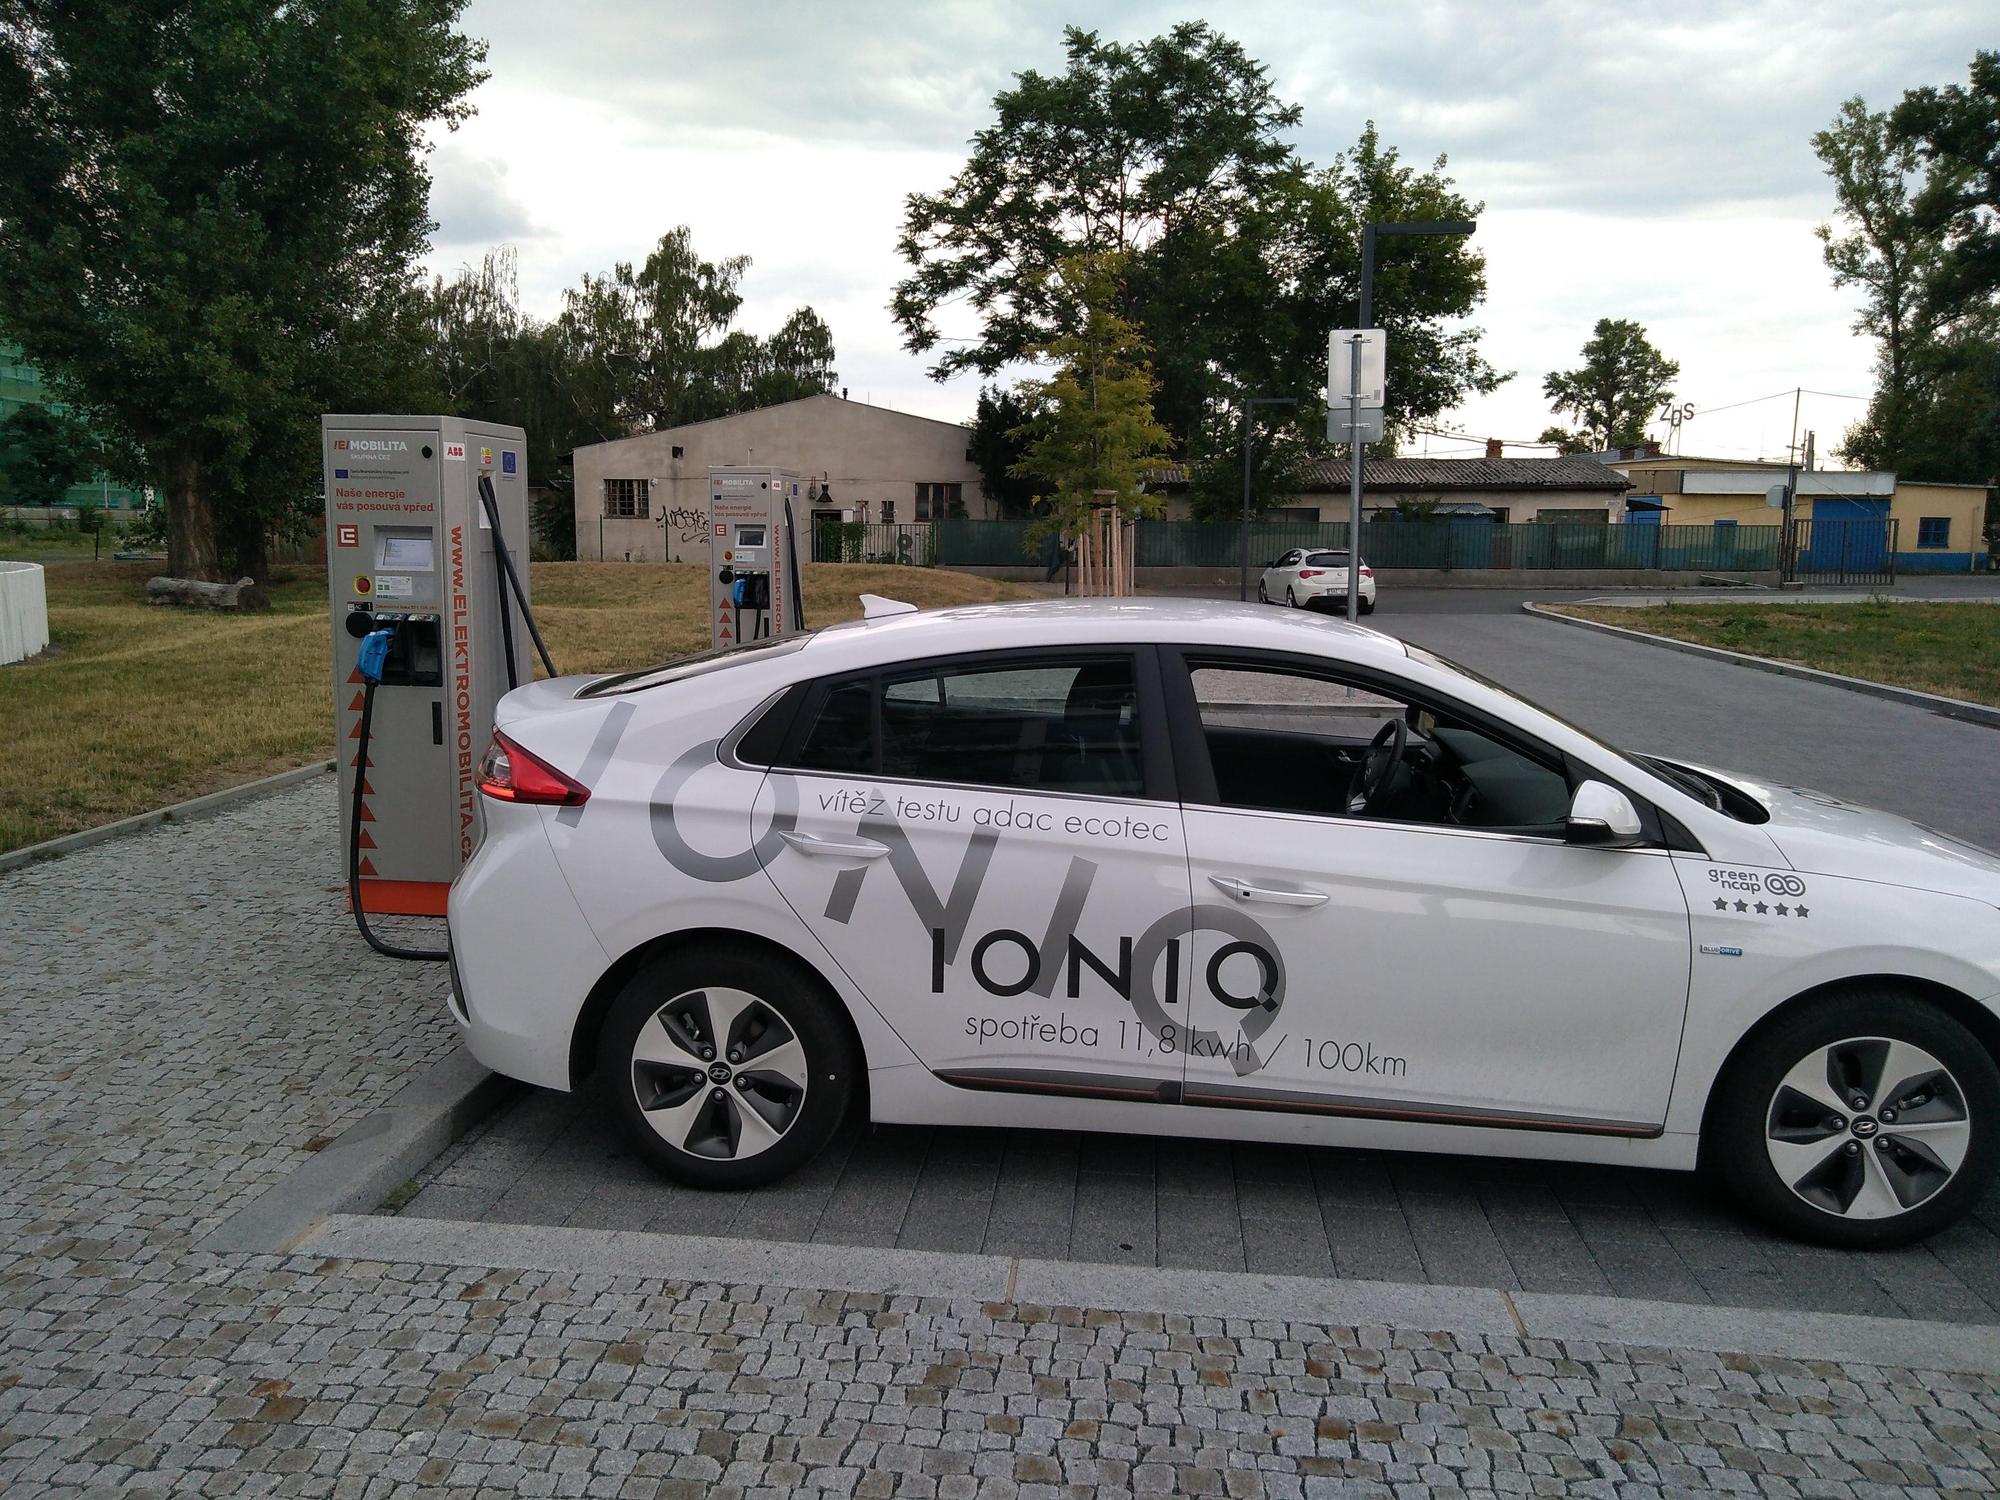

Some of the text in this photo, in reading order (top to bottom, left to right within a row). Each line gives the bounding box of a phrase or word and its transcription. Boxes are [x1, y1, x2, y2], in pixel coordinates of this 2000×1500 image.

[447, 446, 463, 457] ABB
[335, 487, 405, 500] Naše energie
[357, 501, 401, 512] posouvá
[403, 502, 434, 513] vpřed
[818, 789, 1169, 842] vítěz testu adac ecotec
[1708, 869, 1759, 882] green
[1721, 880, 1761, 895] ncap
[931, 928, 1279, 1013] IONIQ
[965, 1012, 1099, 1047] spotřeba
[1118, 1020, 1177, 1058] 11,8
[1190, 1025, 1252, 1062] kwh
[1304, 1038, 1407, 1077] 100km
